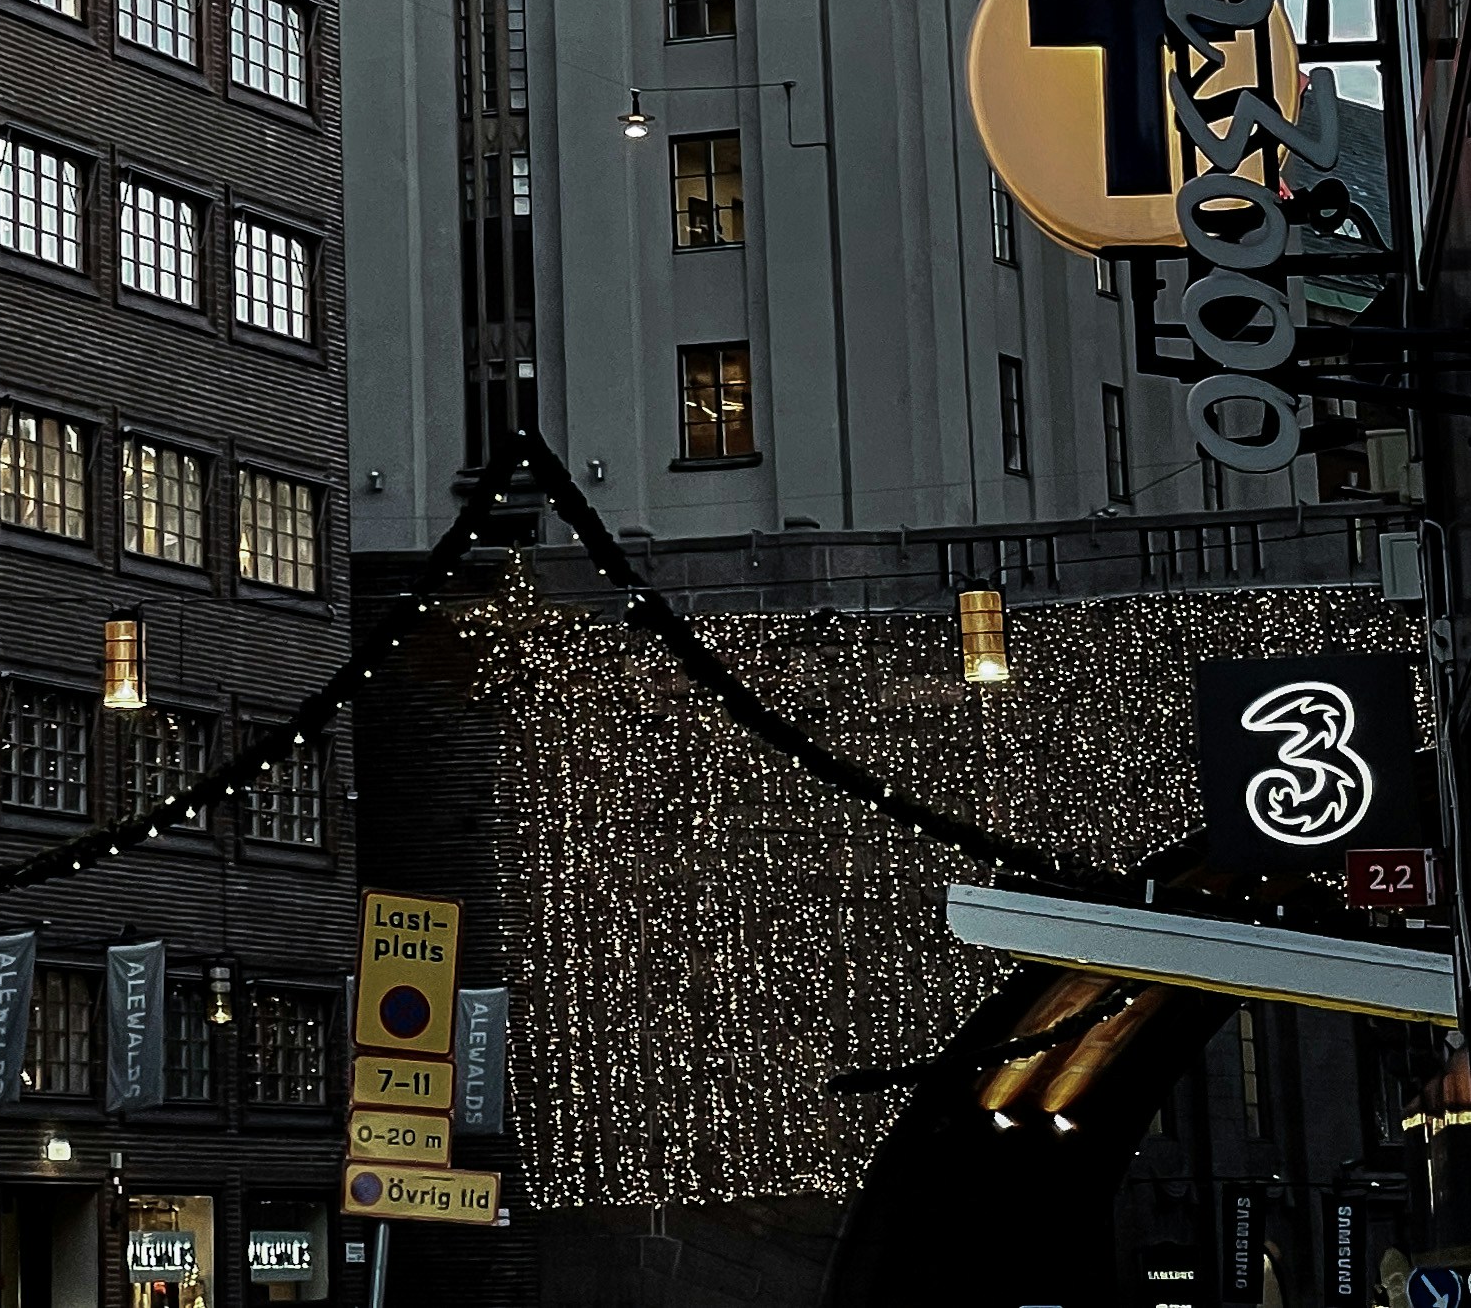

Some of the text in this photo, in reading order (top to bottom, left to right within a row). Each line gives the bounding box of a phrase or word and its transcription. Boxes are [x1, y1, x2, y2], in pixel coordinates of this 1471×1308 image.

[1241, 681, 1373, 845] 3
[375, 904, 448, 931] Last-
[374, 936, 444, 963] plats
[125, 962, 146, 1098] ALEWALDS
[464, 1002, 488, 1125] ALEWALDS
[377, 1069, 430, 1096] 7-11
[357, 1124, 442, 1149] 0-20 m
[388, 1178, 451, 1210] Övrig
[1337, 1206, 1352, 1295] SAMSUNG
